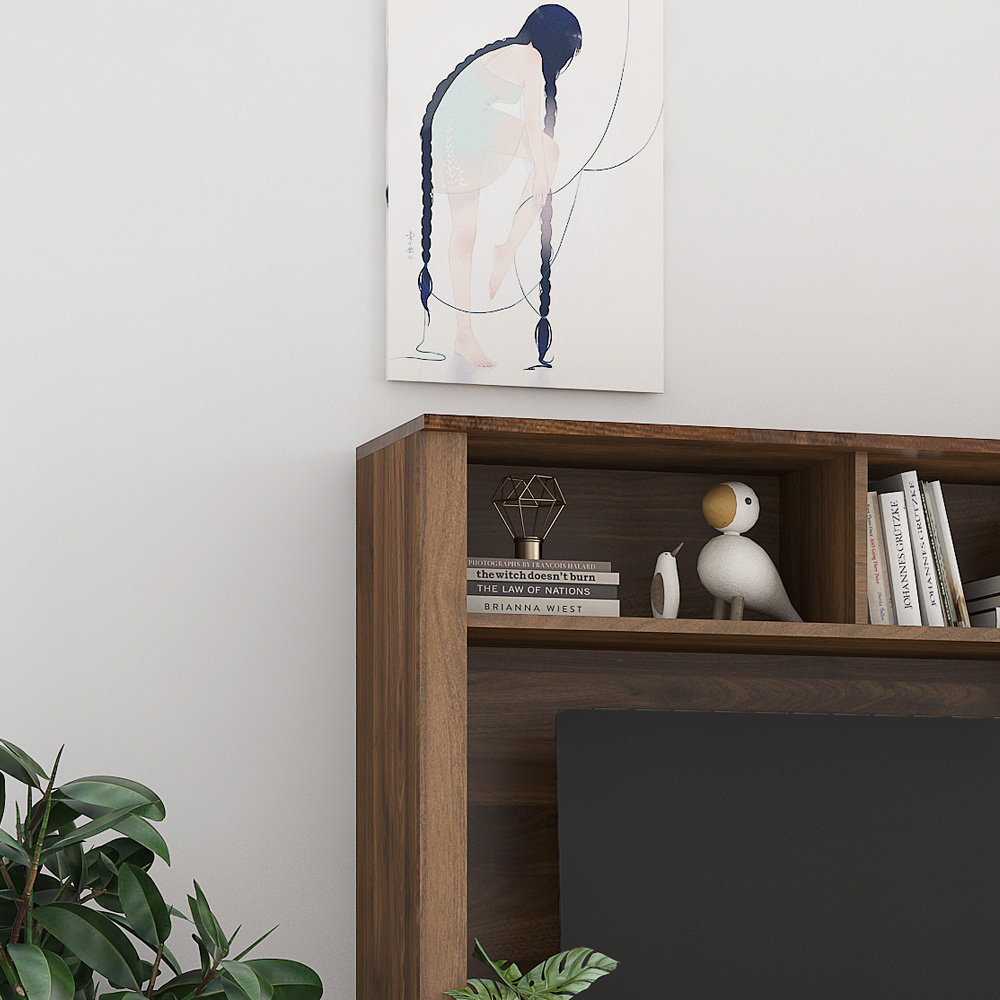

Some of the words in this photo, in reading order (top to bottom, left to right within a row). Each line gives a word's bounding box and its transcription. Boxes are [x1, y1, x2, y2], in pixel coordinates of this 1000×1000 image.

[477, 570, 494, 579] the
[495, 571, 526, 580] witch
[528, 571, 568, 581] doesn't
[570, 573, 595, 582] burn
[918, 541, 937, 606] JOHANNES
[897, 553, 913, 609] JOHANNES
[477, 584, 497, 593] THE
[502, 585, 524, 593] LAW
[528, 586, 541, 594] OF
[545, 587, 591, 595] NATIONS
[484, 603, 540, 611] BRIANNA
[547, 605, 582, 613] WIEST
